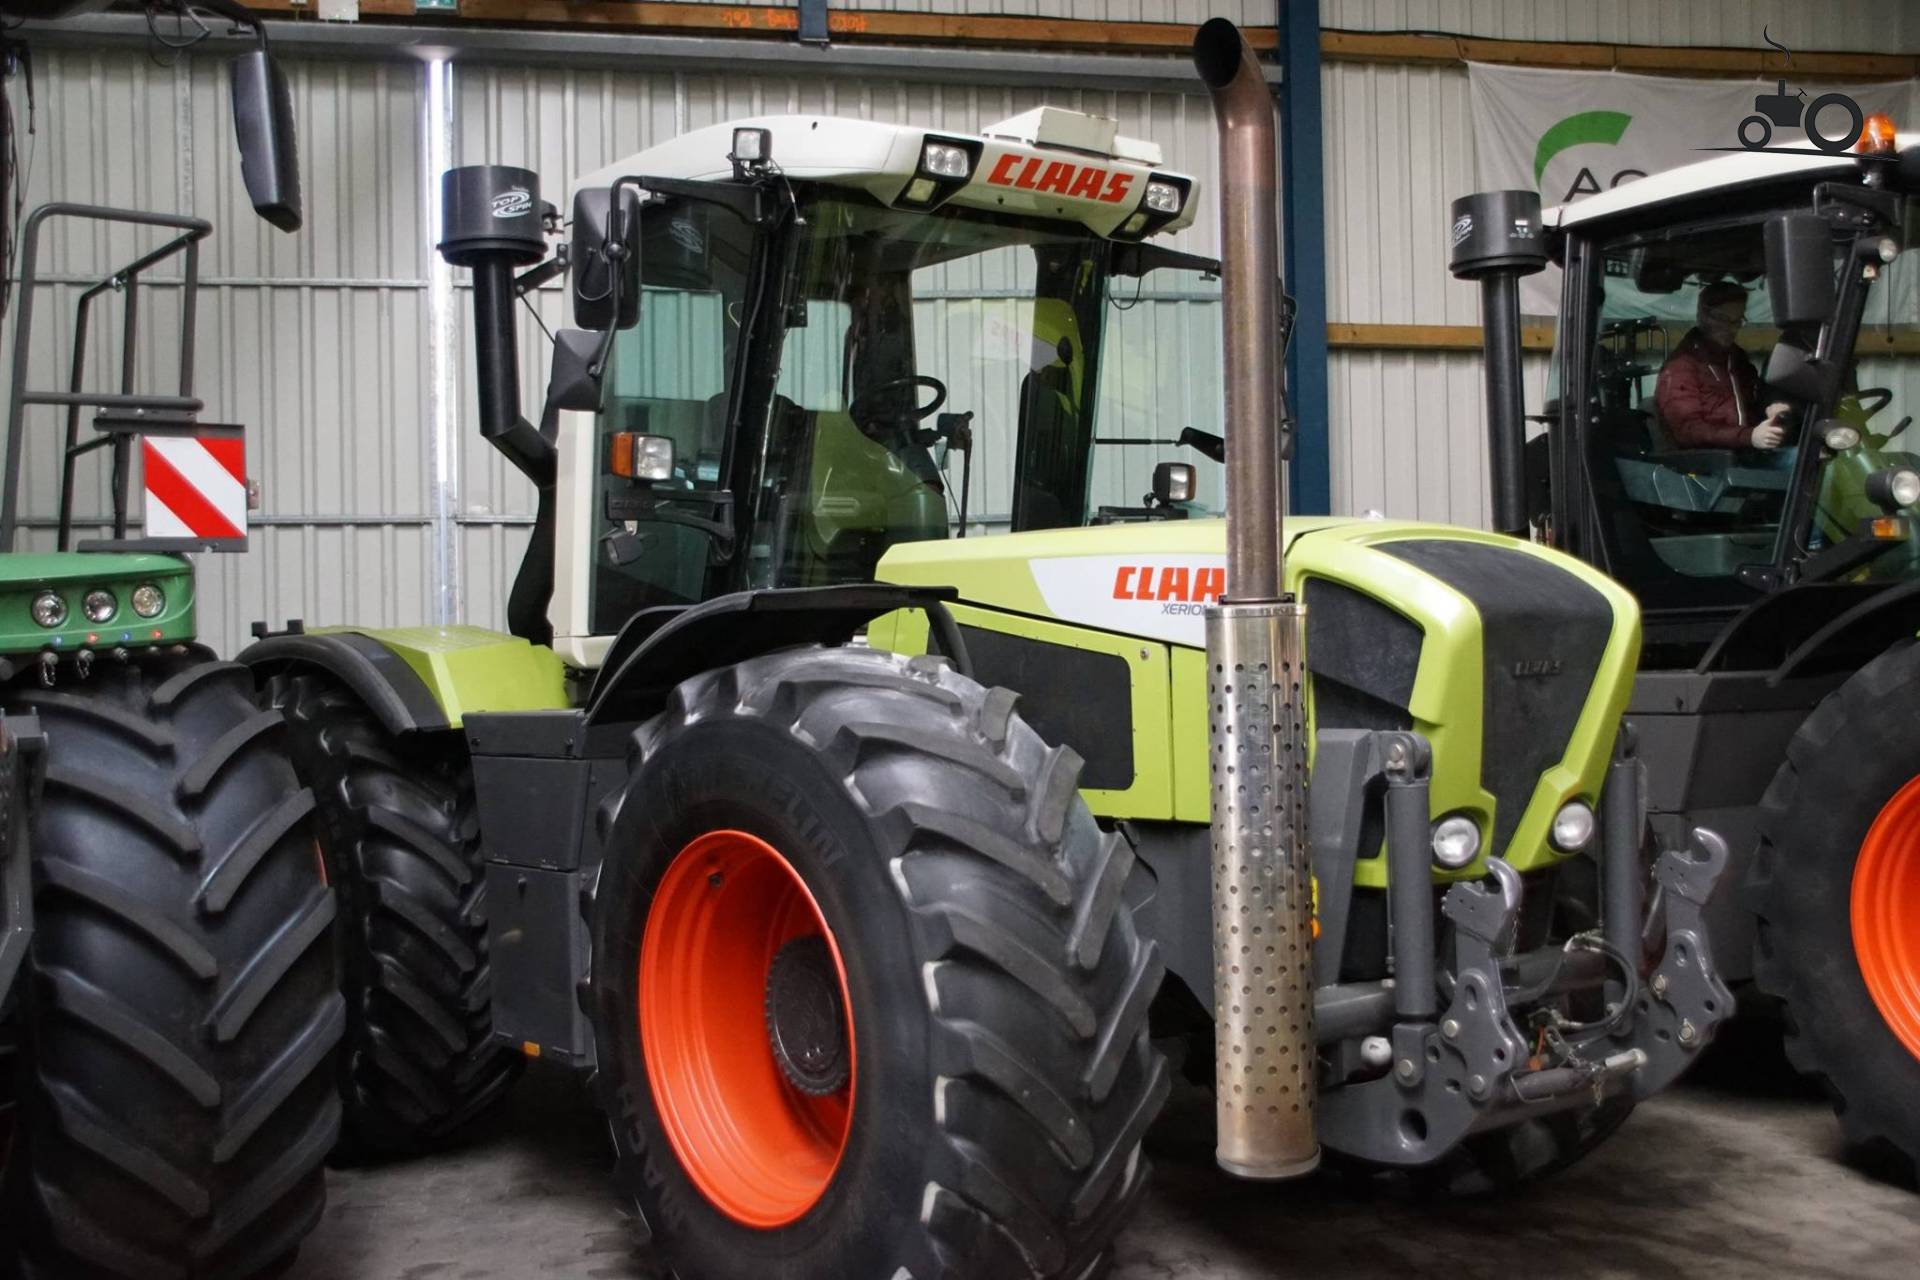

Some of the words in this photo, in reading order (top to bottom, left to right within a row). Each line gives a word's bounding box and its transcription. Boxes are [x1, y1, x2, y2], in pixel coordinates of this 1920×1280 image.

[987, 153, 1134, 203] CLAAS
[490, 196, 519, 209] TOP
[1112, 566, 1225, 602] CLAA
